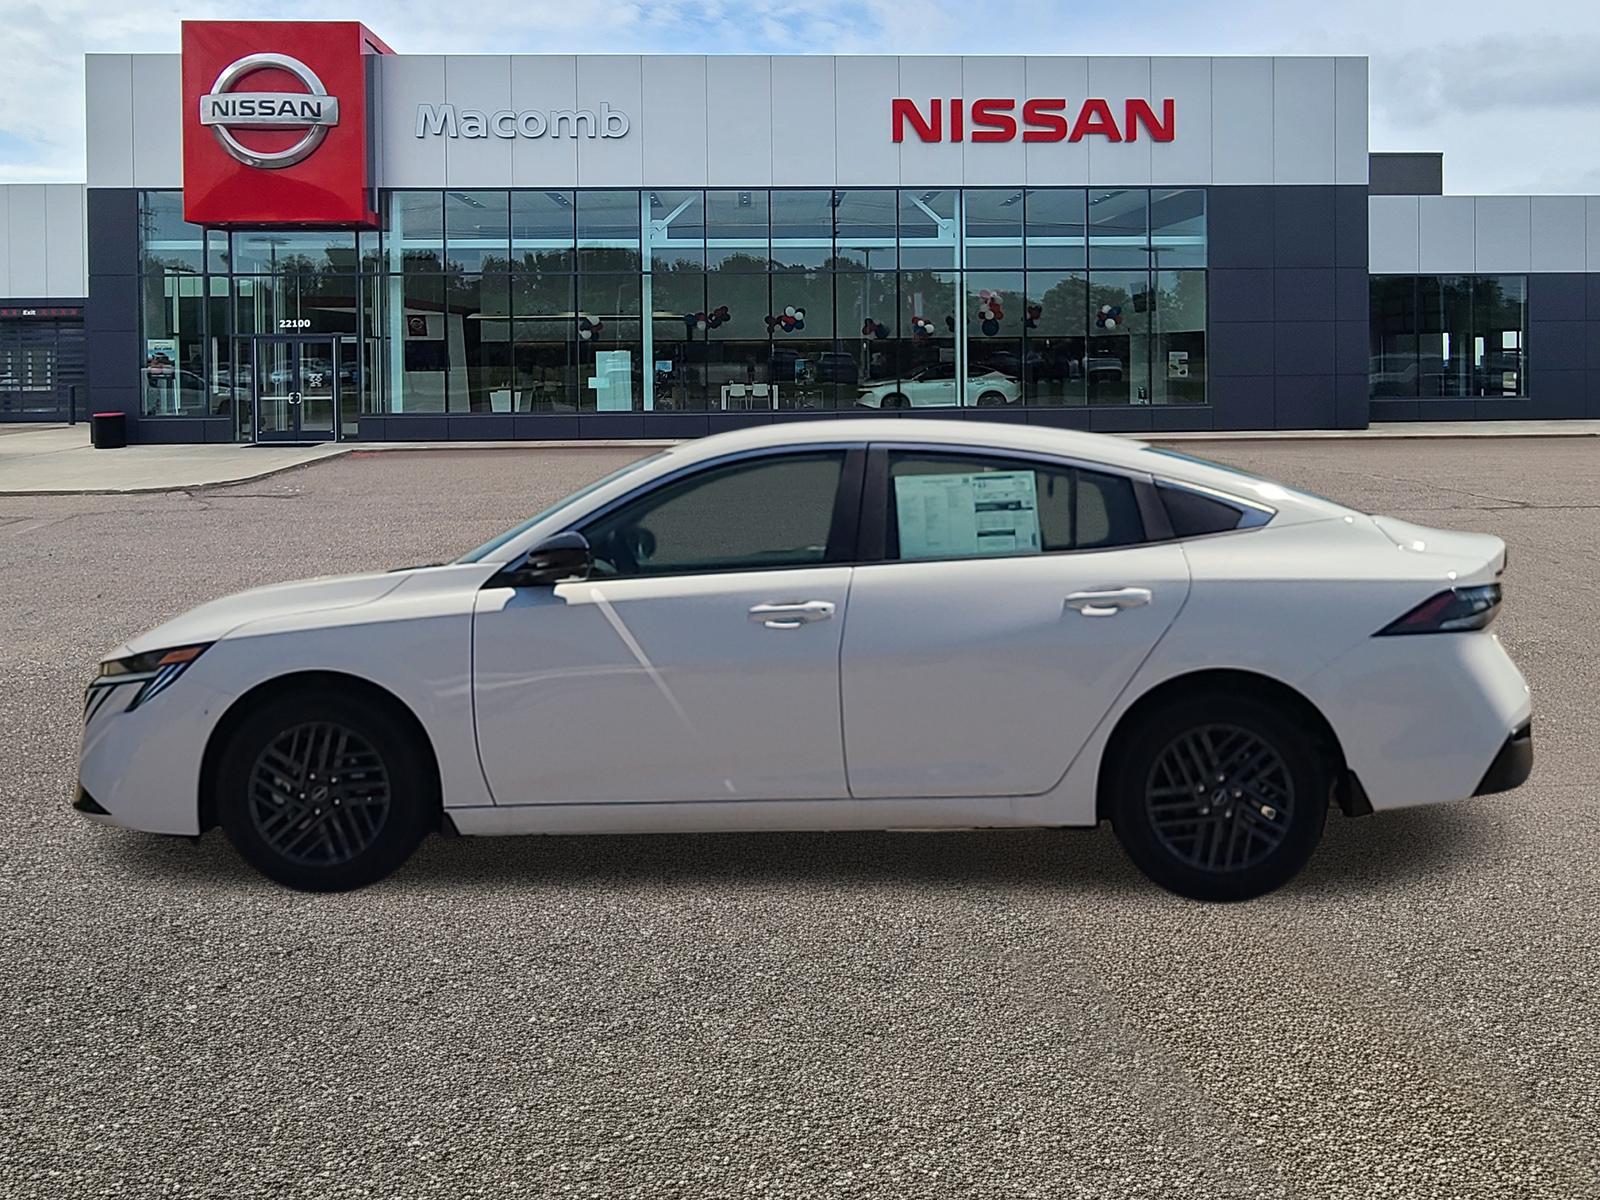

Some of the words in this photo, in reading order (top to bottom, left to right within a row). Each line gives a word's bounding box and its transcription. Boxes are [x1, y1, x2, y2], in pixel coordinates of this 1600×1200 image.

[211, 100, 323, 118] NISSAN
[415, 102, 631, 140] Macomb
[891, 98, 1175, 143] NISSAN
[279, 319, 312, 328] 22100
